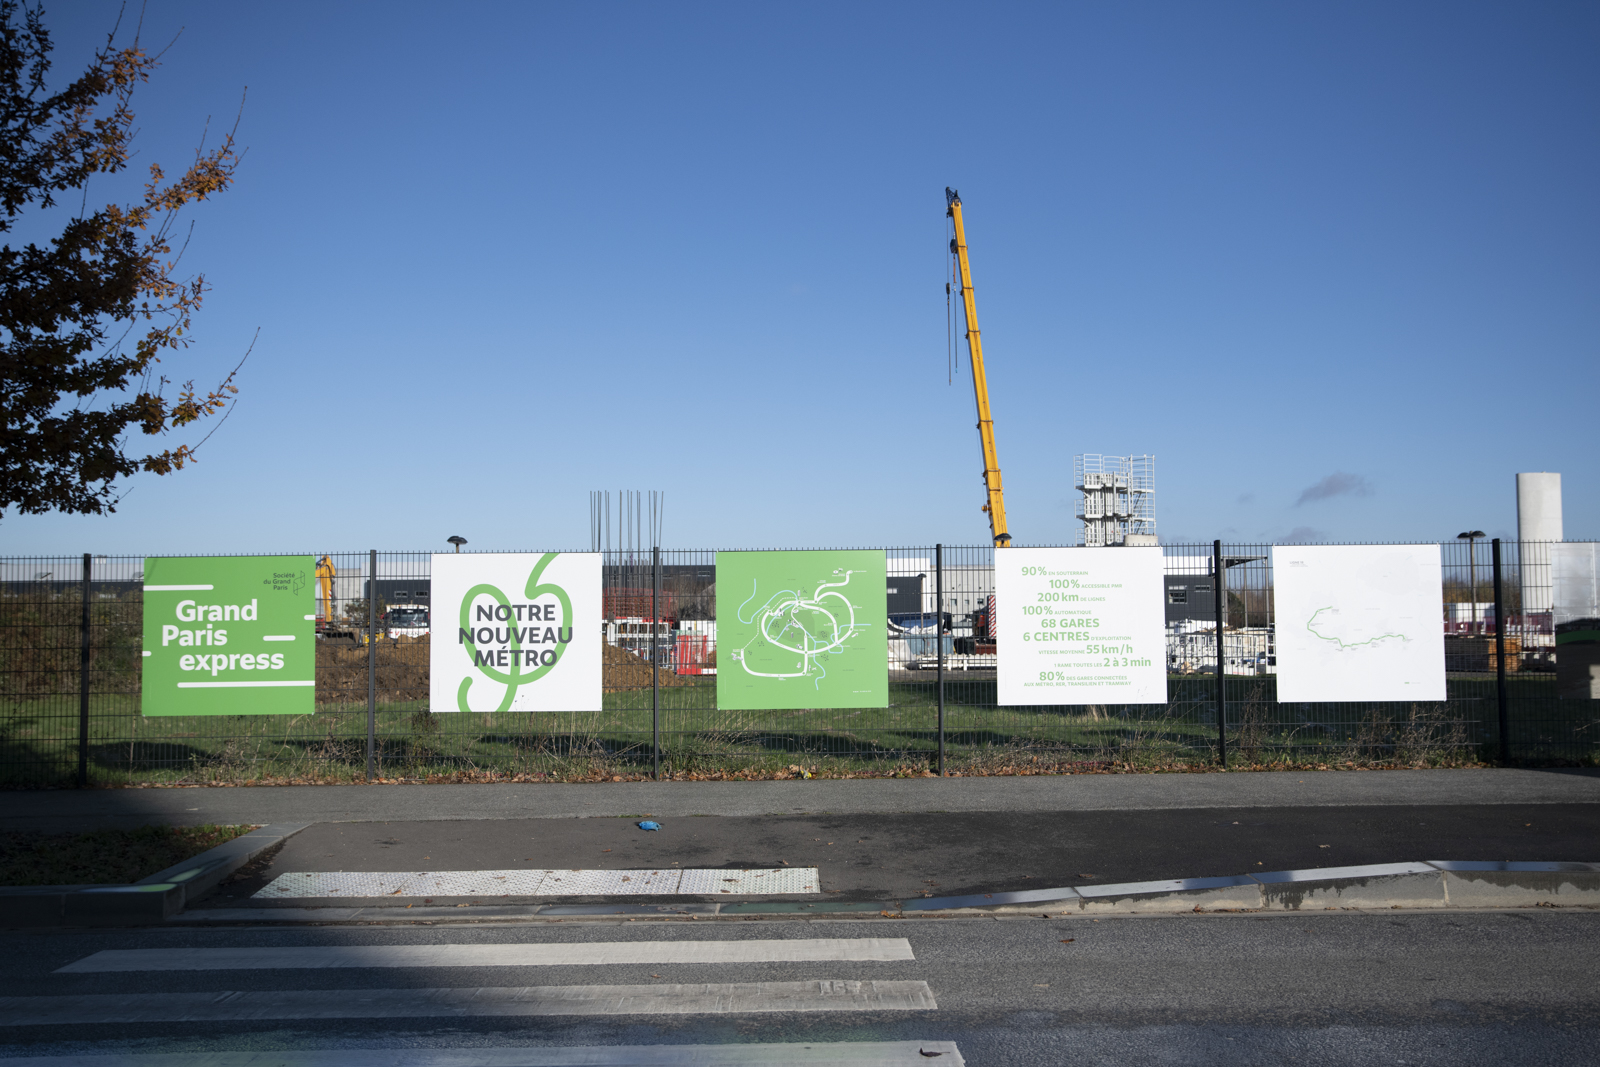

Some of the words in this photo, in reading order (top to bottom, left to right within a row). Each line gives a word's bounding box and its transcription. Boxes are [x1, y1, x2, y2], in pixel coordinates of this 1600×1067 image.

[1037, 593, 1060, 602] 200
[1062, 592, 1079, 601] km
[176, 599, 258, 622] Grand
[477, 605, 555, 621] NOTRE
[1041, 619, 1056, 628] 68
[1060, 619, 1099, 628] GARES
[162, 624, 228, 646] Paris
[459, 627, 573, 644] NOUVEAU
[1023, 632, 1030, 641] 6
[1034, 632, 1089, 641] CENTRES
[474, 646, 557, 666] MÉTRO
[1086, 645, 1099, 654] 55
[179, 653, 284, 676] express
[1104, 658, 1110, 666] 2
[1113, 657, 1119, 666] à
[1122, 657, 1128, 666] 3
[1131, 657, 1151, 666] min
